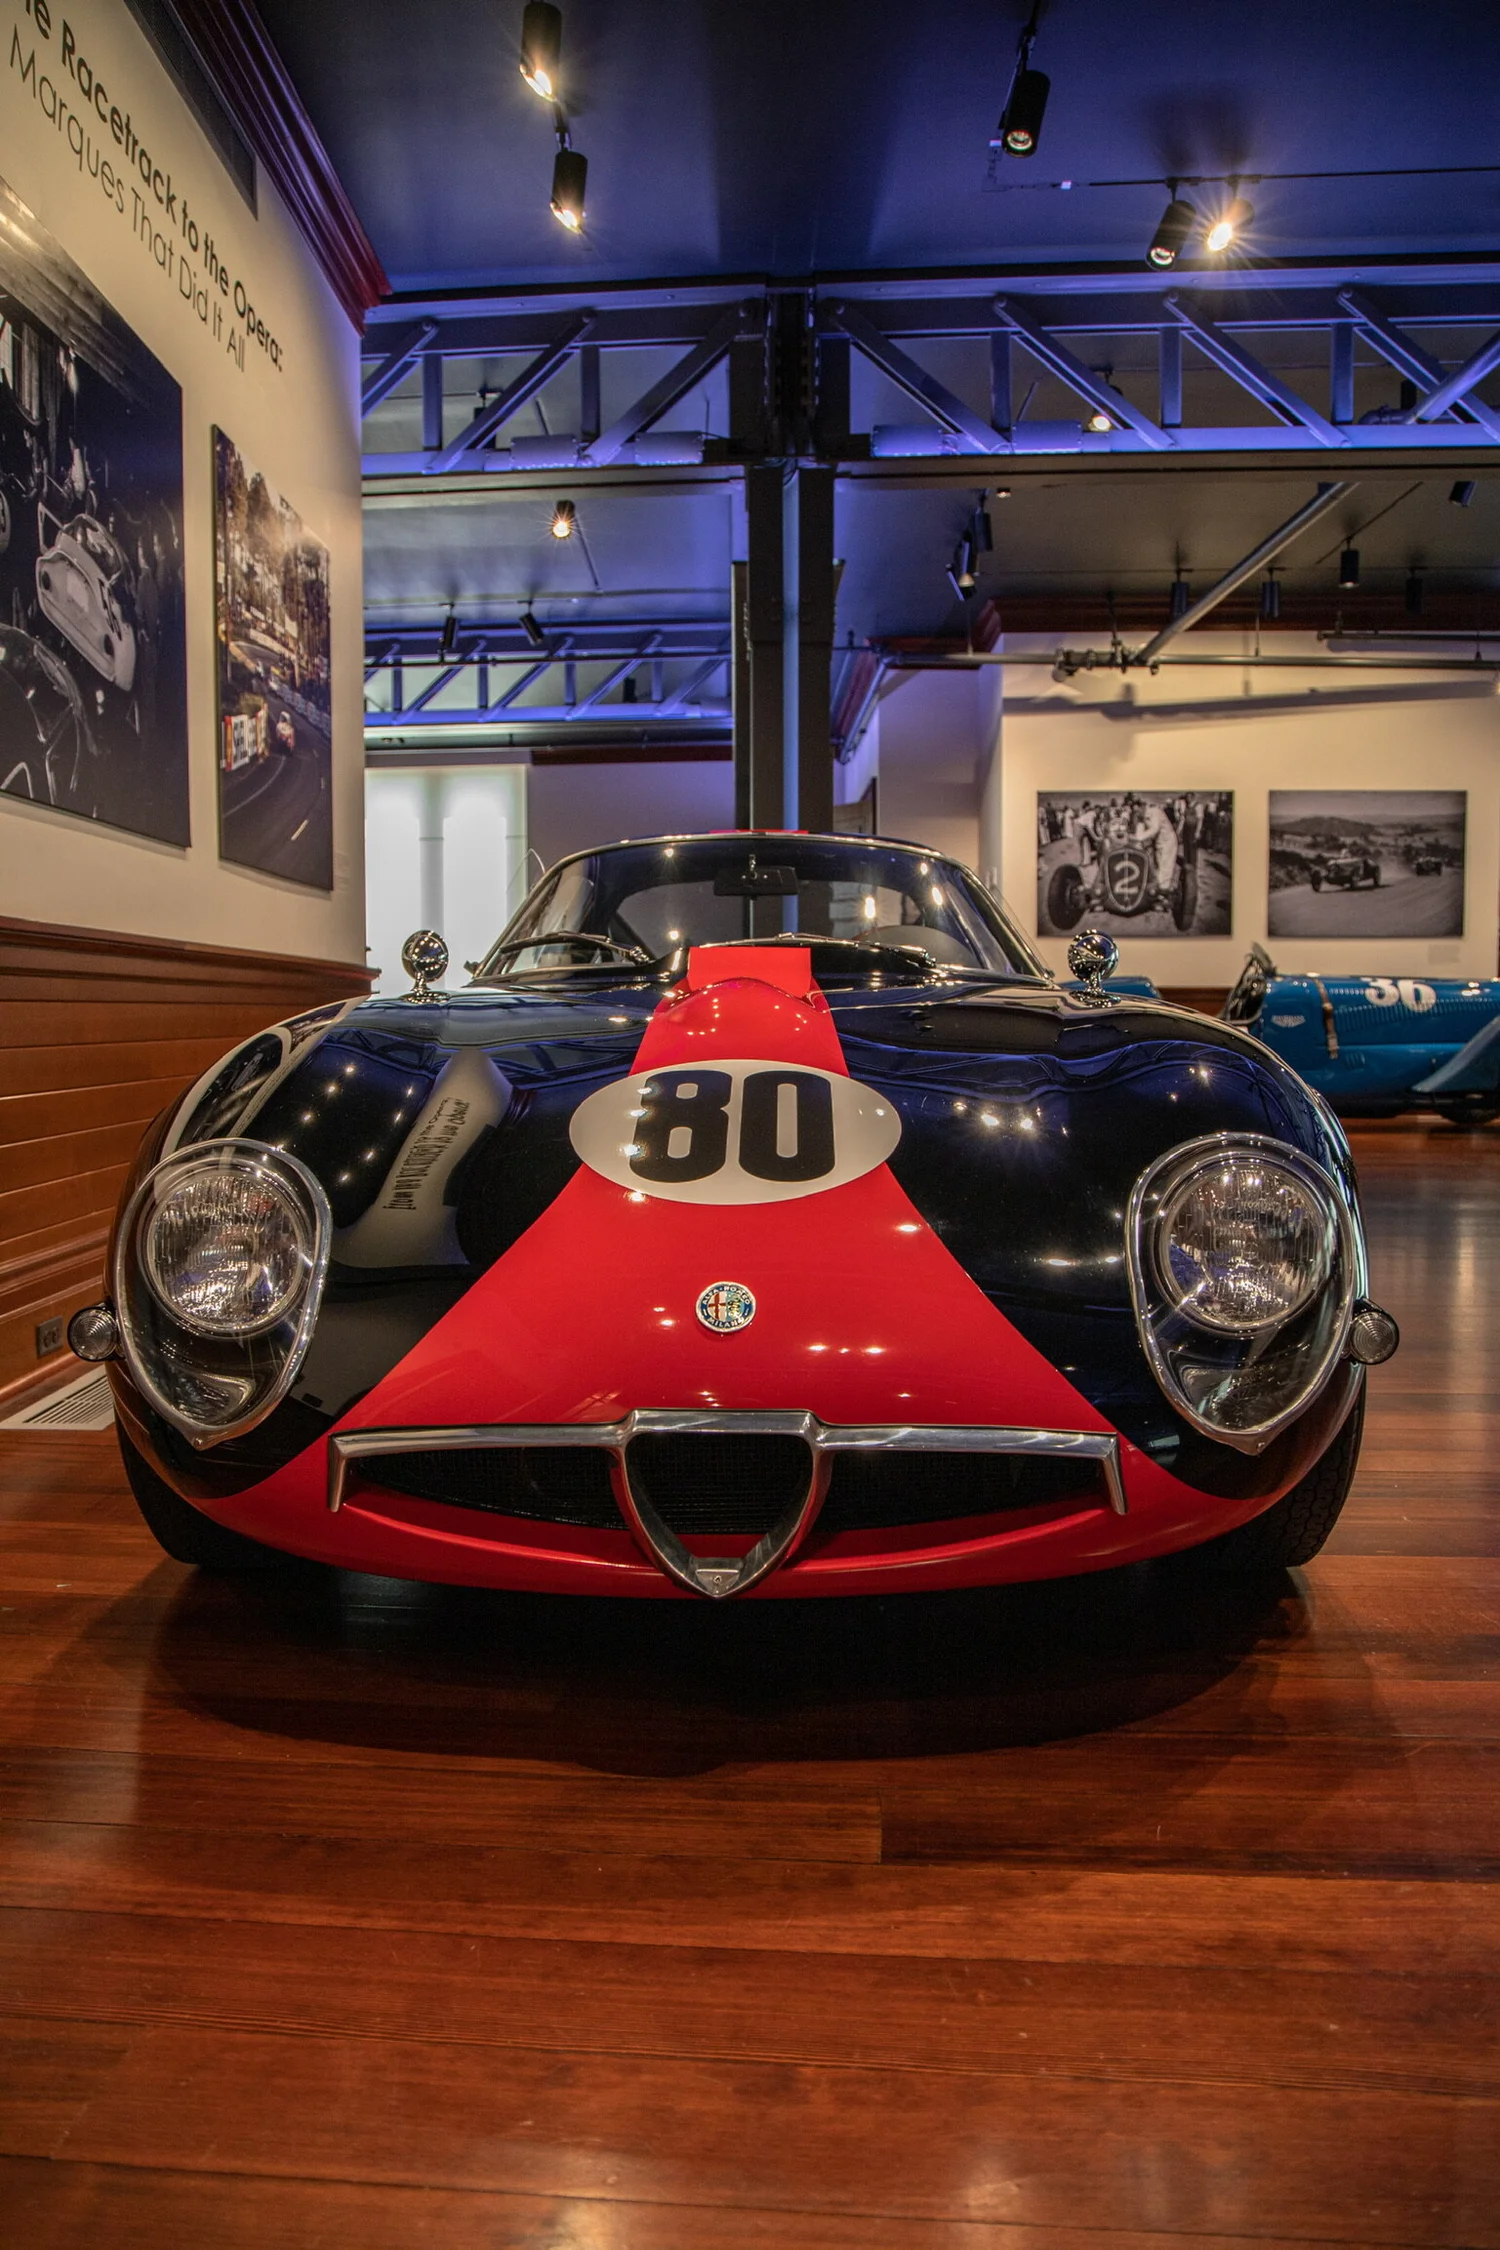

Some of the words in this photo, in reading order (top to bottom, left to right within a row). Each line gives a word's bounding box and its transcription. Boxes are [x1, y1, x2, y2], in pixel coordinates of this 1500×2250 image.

[10, 23, 125, 213] Marques
[131, 186, 173, 277] That
[180, 255, 208, 324] Did
[213, 302, 223, 342] It
[227, 328, 244, 372] All
[61, 19, 176, 224] Racetrack
[182, 200, 199, 252] to
[204, 232, 229, 297] the
[234, 280, 283, 372] Opera:
[1114, 860, 1140, 894] 2
[1363, 977, 1437, 1013] 36
[629, 1069, 835, 1183] 80
